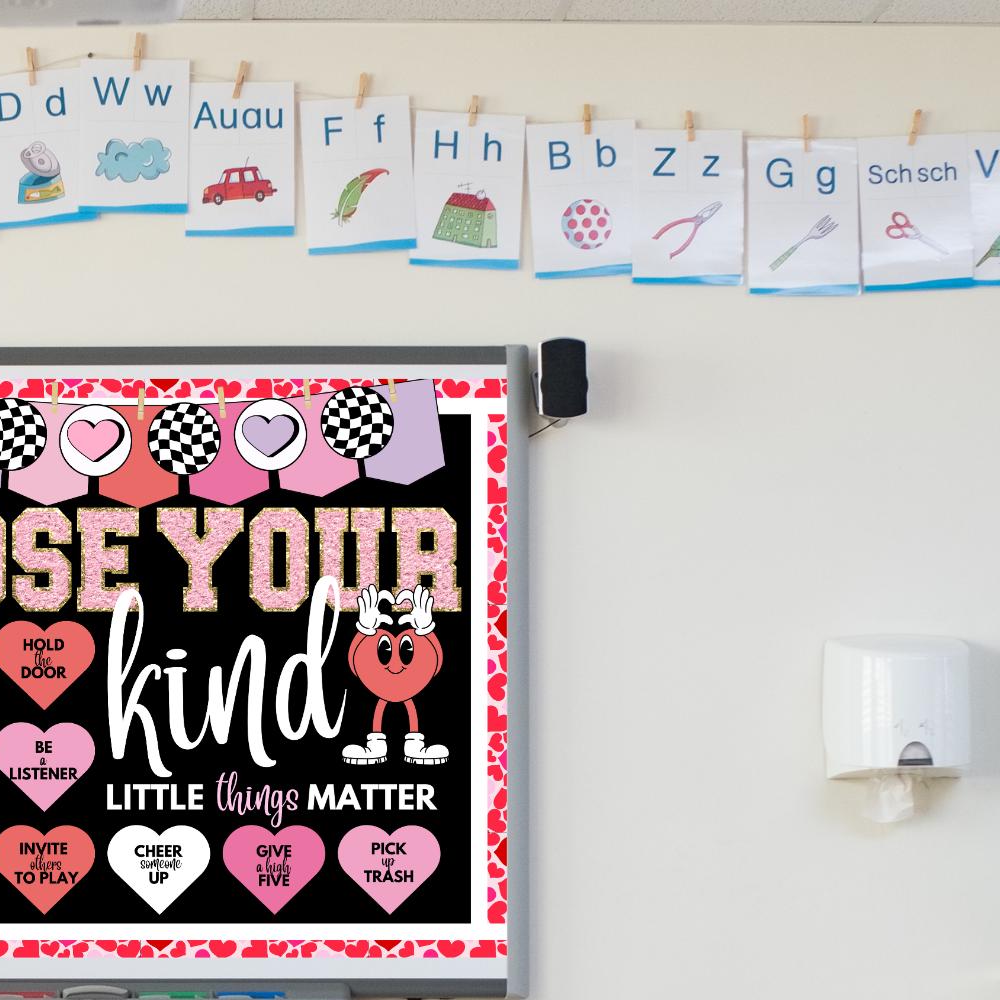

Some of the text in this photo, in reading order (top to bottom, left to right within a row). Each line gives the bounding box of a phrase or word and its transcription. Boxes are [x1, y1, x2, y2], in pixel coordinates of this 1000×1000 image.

[93, 77, 172, 106] W w
[46, 87, 66, 116] d
[324, 114, 385, 145] F f
[434, 130, 501, 161] H h
[549, 139, 616, 170] B b
[653, 147, 719, 176] Z z
[975, 150, 999, 178] V
[766, 158, 835, 194] G g
[156, 507, 462, 612] YOUR
[23, 638, 65, 651] HOLD
[34, 650, 53, 667] the
[21, 666, 67, 679] DOOR
[107, 575, 348, 778] kind
[35, 740, 53, 754] BE
[39, 756, 47, 766] a
[9, 767, 78, 780] LISTENER
[106, 771, 438, 828] LITTLE things MATTER
[19, 842, 68, 855] INVITE
[134, 844, 183, 858] CHEER
[256, 844, 292, 858] GIVE
[371, 842, 407, 855] PICK
[29, 853, 62, 872] others
[140, 857, 182, 872] someone
[256, 856, 292, 876] a high
[381, 856, 396, 873] up
[14, 871, 79, 885] TO PLAY
[148, 871, 169, 885] UP
[258, 874, 290, 887] FIVE
[364, 870, 414, 883] TRASH
